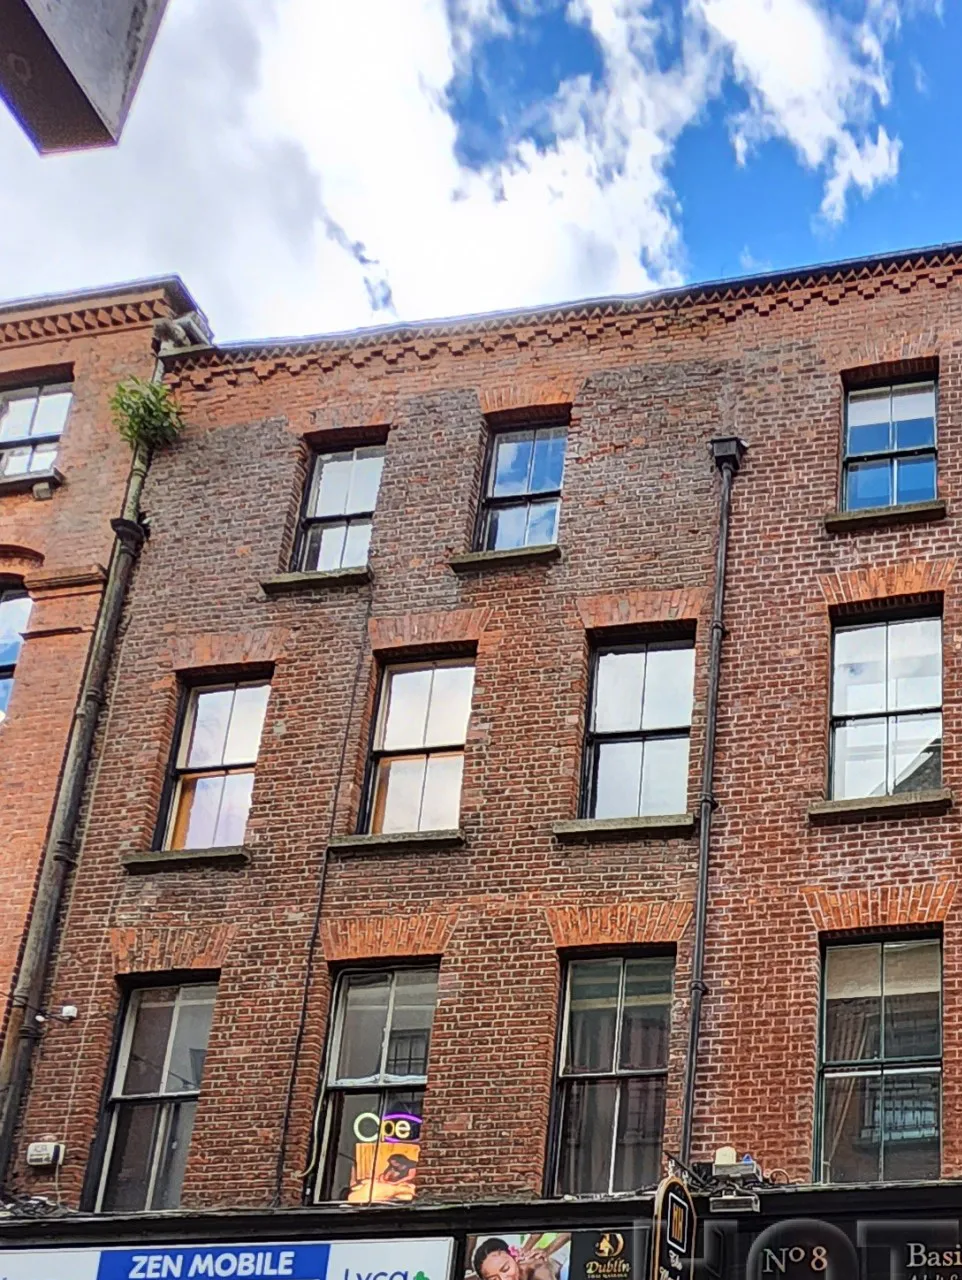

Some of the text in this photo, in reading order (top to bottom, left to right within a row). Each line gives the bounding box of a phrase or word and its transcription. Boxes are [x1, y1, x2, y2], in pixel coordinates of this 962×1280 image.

[128, 1251, 295, 1279] ZEN MOBILE
[585, 1258, 631, 1274] Dublin
[810, 1245, 828, 1271] 8
